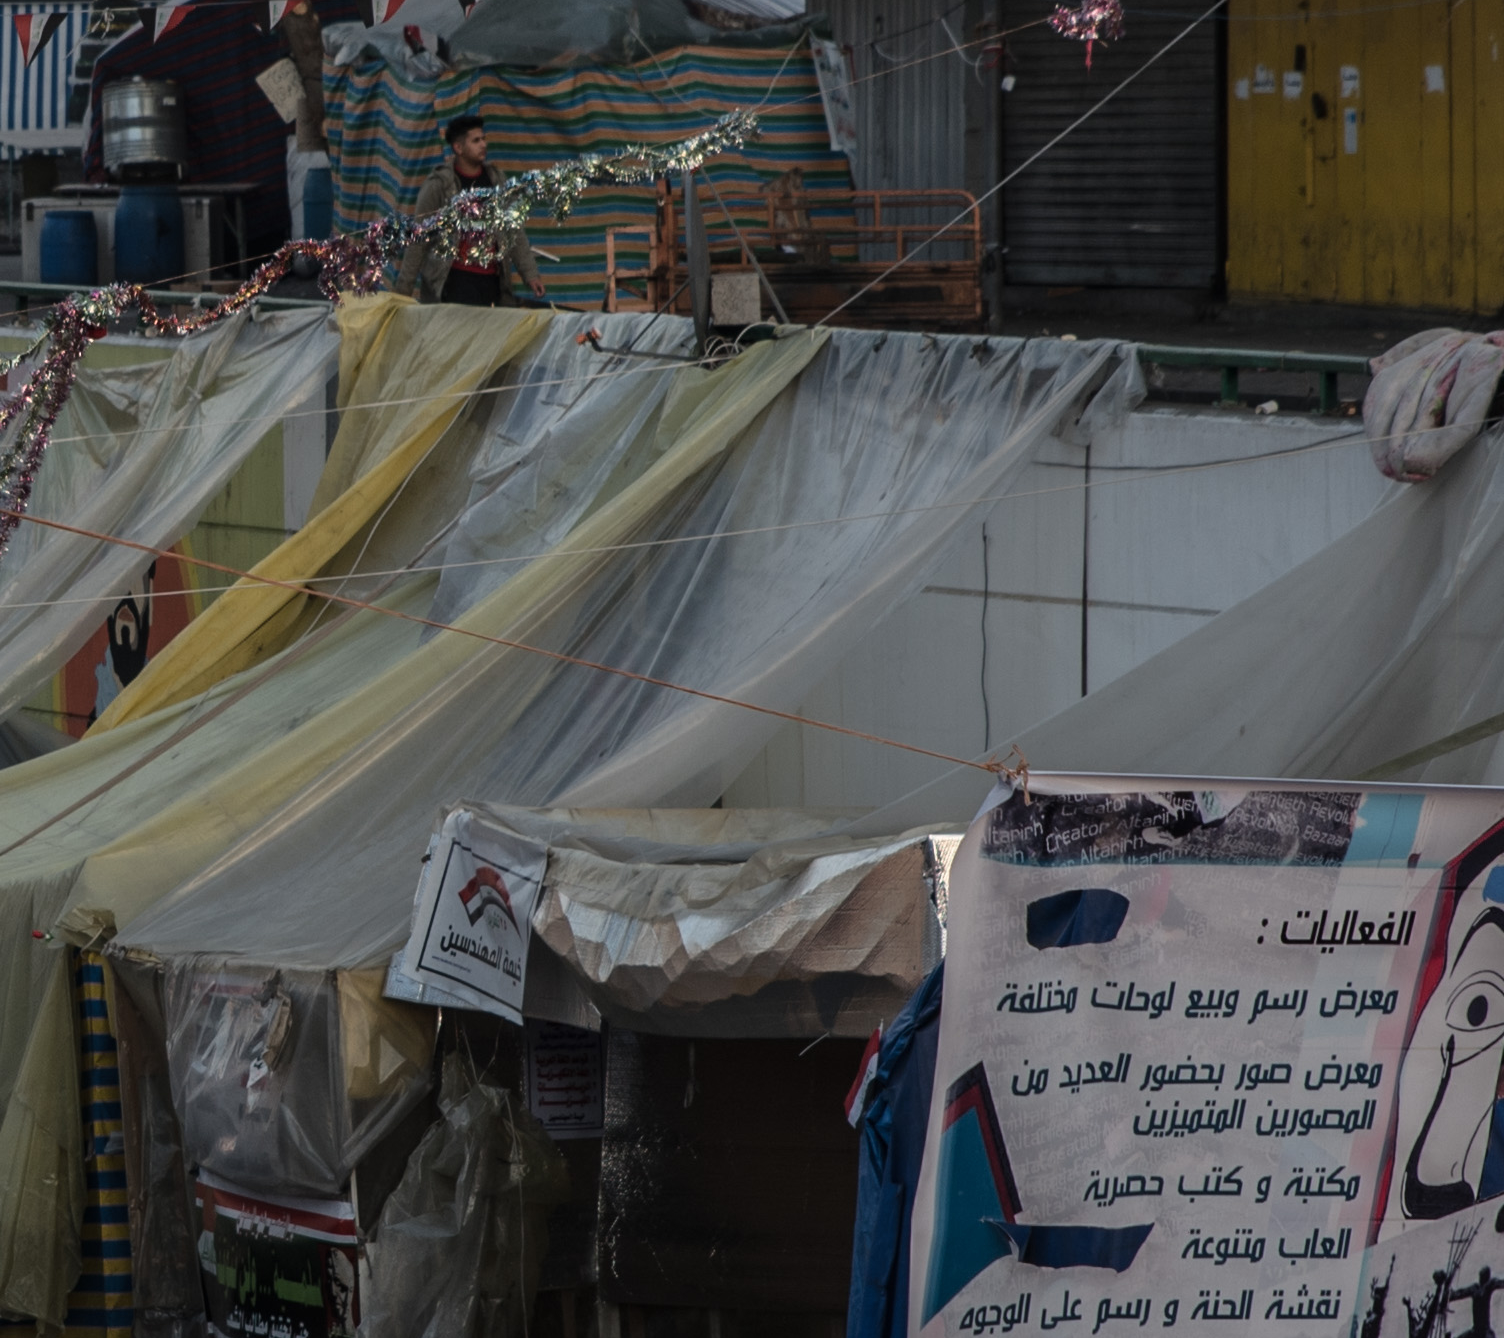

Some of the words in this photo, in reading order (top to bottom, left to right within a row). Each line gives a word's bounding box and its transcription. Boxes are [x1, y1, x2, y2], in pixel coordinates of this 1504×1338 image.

[439, 924, 504, 971] المهندسين
[1279, 909, 1417, 954] الفعاليات
[996, 978, 1080, 1015] مختلفة
[1090, 980, 1177, 1020] لوحات
[1184, 988, 1241, 1020] وبيع
[1248, 987, 1308, 1025] رسم
[1319, 981, 1399, 1019] معرض
[1010, 1058, 1051, 1097] من
[1058, 1052, 1133, 1094] العديد
[1139, 1056, 1226, 1092] بحضور
[1234, 1060, 1293, 1092] صور
[1303, 1053, 1384, 1091] معرض
[1132, 1098, 1247, 1137] المتميزين
[1255, 1099, 1378, 1137] المصورين
[1083, 1166, 1165, 1207] حصرية
[1177, 1164, 1246, 1204] كتب
[1255, 1175, 1273, 1203] و
[1283, 1164, 1362, 1202] مكتبة
[1181, 1228, 1266, 1264] متنوعة
[1277, 1228, 1352, 1266] العاب
[959, 1293, 1032, 1336] الوجوه
[1039, 1290, 1084, 1330] على
[1092, 1296, 1153, 1335] رسم
[1163, 1297, 1180, 1323] و
[1190, 1289, 1254, 1322] الحنة
[1263, 1283, 1342, 1322] نقشة
